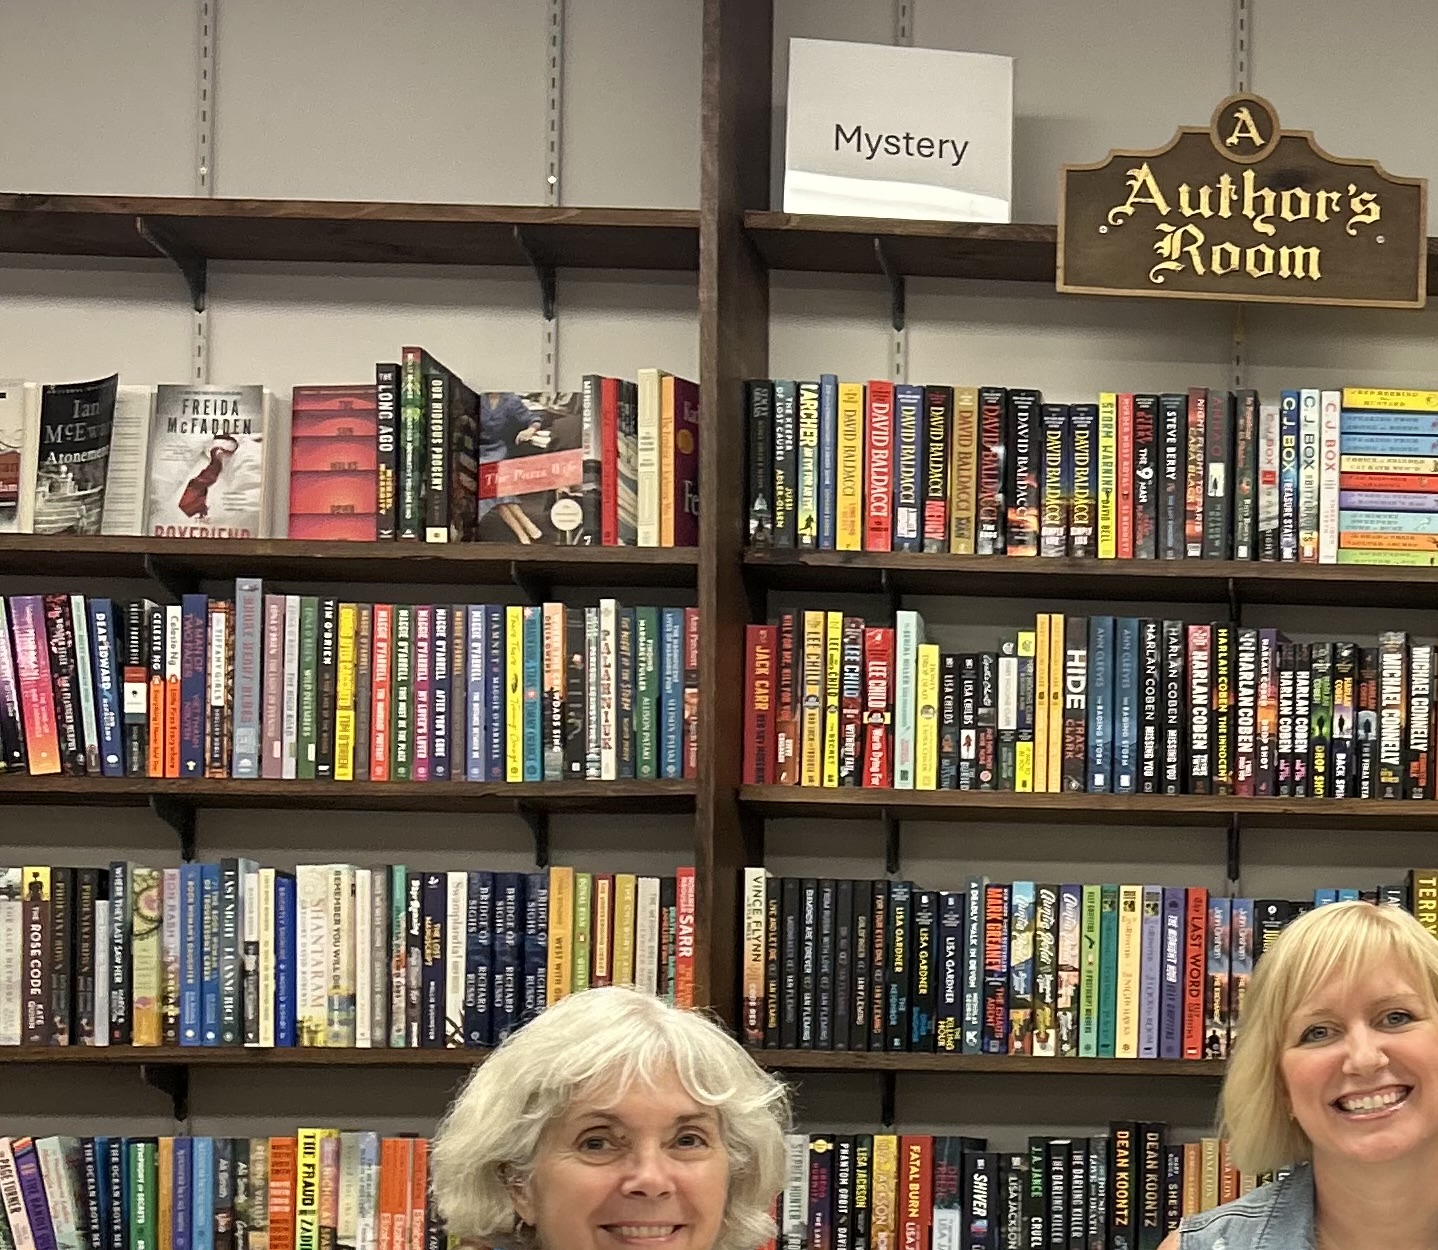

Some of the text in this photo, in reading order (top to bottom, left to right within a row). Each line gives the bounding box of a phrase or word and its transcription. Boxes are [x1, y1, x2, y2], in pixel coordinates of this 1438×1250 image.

[834, 123, 969, 166] Mystery
[1226, 108, 1266, 147] A
[1108, 162, 1380, 236] Author's
[1150, 224, 1322, 283] Room
[167, 418, 252, 434] McFADDEN
[182, 399, 239, 416] FREIDA
[800, 390, 818, 446] ARCHER
[929, 406, 945, 439] DAVID
[1282, 397, 1297, 472] C. J. BOX
[870, 402, 890, 516] DAVID BALDACCI
[899, 406, 916, 504] DAVID BALDACCI
[928, 442, 944, 497] BALDACCI
[1101, 402, 1113, 493] STORM WARNING
[1165, 411, 1177, 479] STEVE BERRY
[754, 646, 770, 709] JACK CARR
[806, 632, 821, 685] LEE CHILD
[868, 662, 886, 678] LEE
[1066, 649, 1085, 709] HIDE
[868, 681, 886, 708] CHILD
[1192, 651, 1208, 749] HARLAN COBEN
[1217, 629, 1228, 782] HARLAN COBEN THE INNOCENT
[1381, 654, 1402, 765] MICHAEL CONNELLY
[1410, 648, 1429, 751] MICHAEL CONNELLY
[1065, 719, 1075, 759] CLARK
[1076, 719, 1084, 759] TRACY
[677, 914, 694, 957] SARR
[751, 876, 763, 963] VINCE FLYNN
[984, 888, 1003, 971] MARK GREANEY
[29, 907, 42, 995] THE ROSE CODE
[308, 899, 326, 1008] SHANTARAM
[918, 928, 929, 994] LISA GARDNER
[944, 937, 955, 1004] LISA GARDNER
[1189, 917, 1202, 998] LAST WORD
[303, 1133, 316, 1159] THE
[908, 1145, 921, 1182] FATAL
[300, 1163, 316, 1206] FRAUD
[908, 1184, 921, 1217] BURN
[972, 1173, 989, 1216] SHIVER
[1113, 1131, 1129, 1226] DEAN KOONTZ
[906, 1222, 915, 1244] LISA
